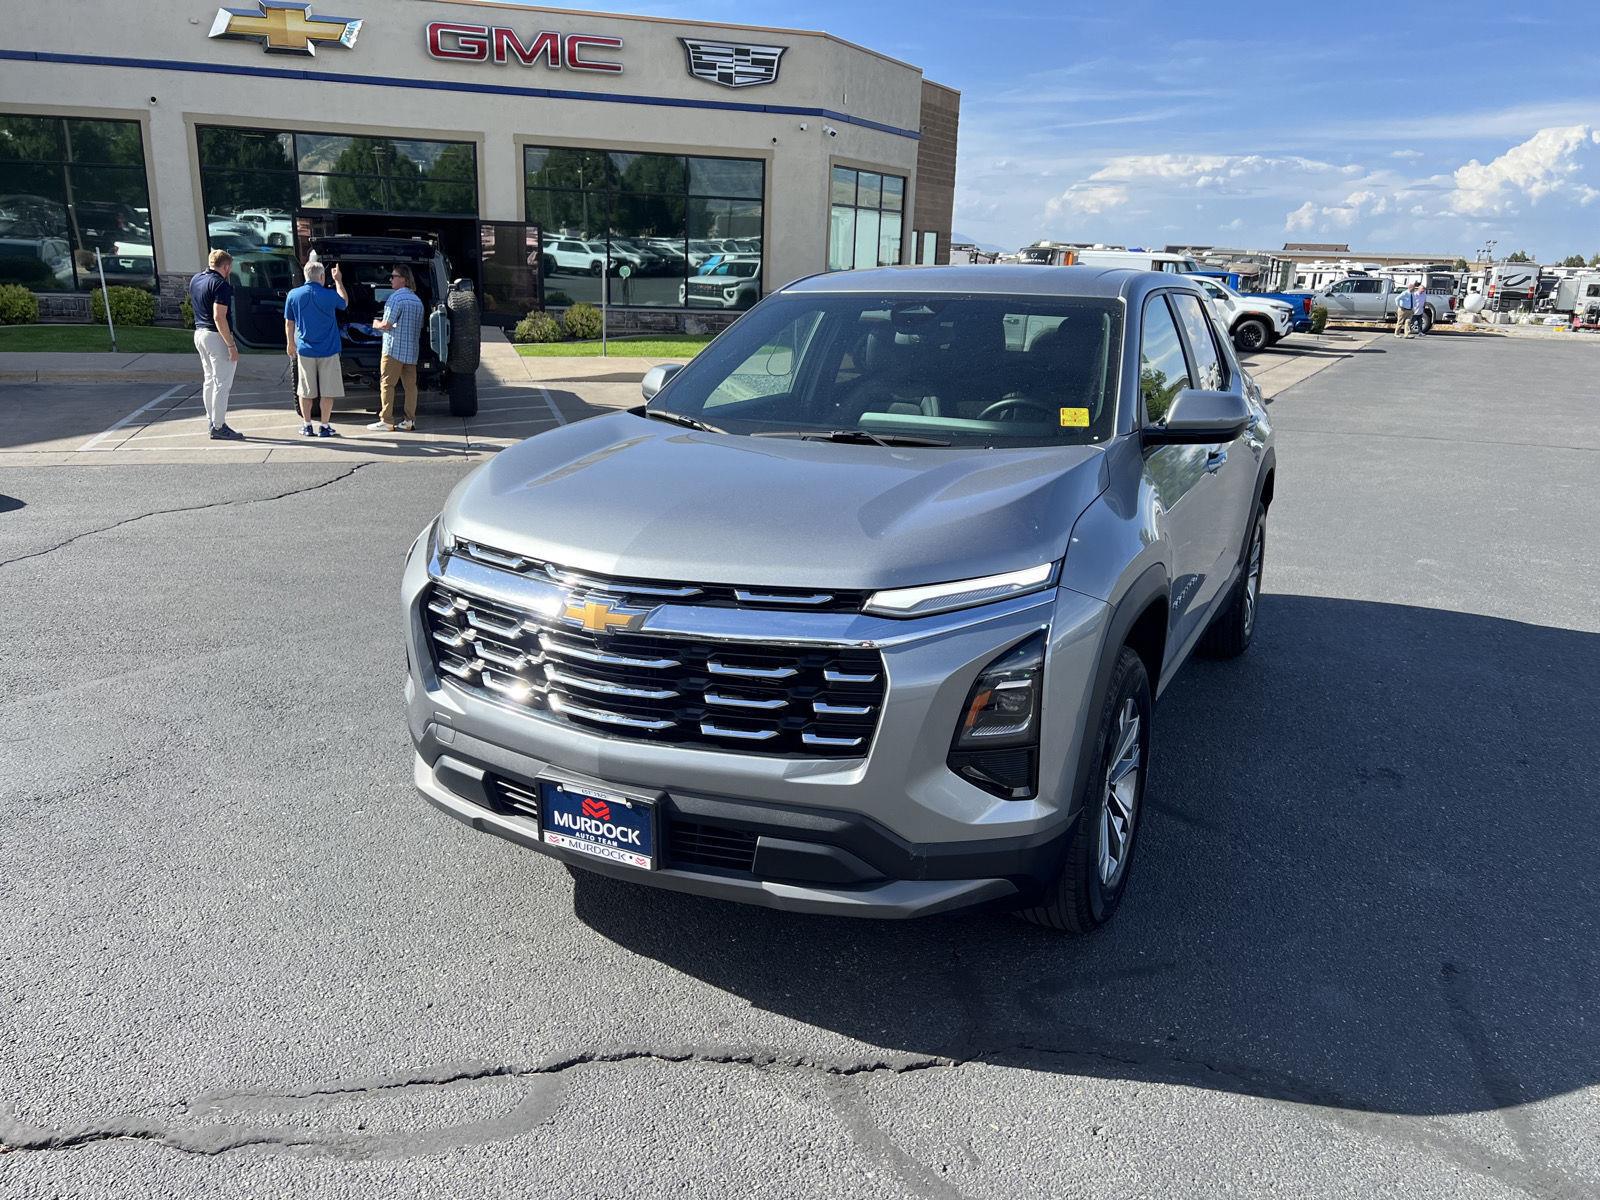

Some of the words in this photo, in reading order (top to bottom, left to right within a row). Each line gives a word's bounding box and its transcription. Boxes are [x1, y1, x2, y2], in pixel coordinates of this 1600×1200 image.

[426, 21, 624, 75] GMC
[553, 810, 641, 846] MURDOCK
[575, 831, 595, 841] AUTO
[597, 836, 618, 847] TEAM
[568, 839, 627, 861] MURDOCK
